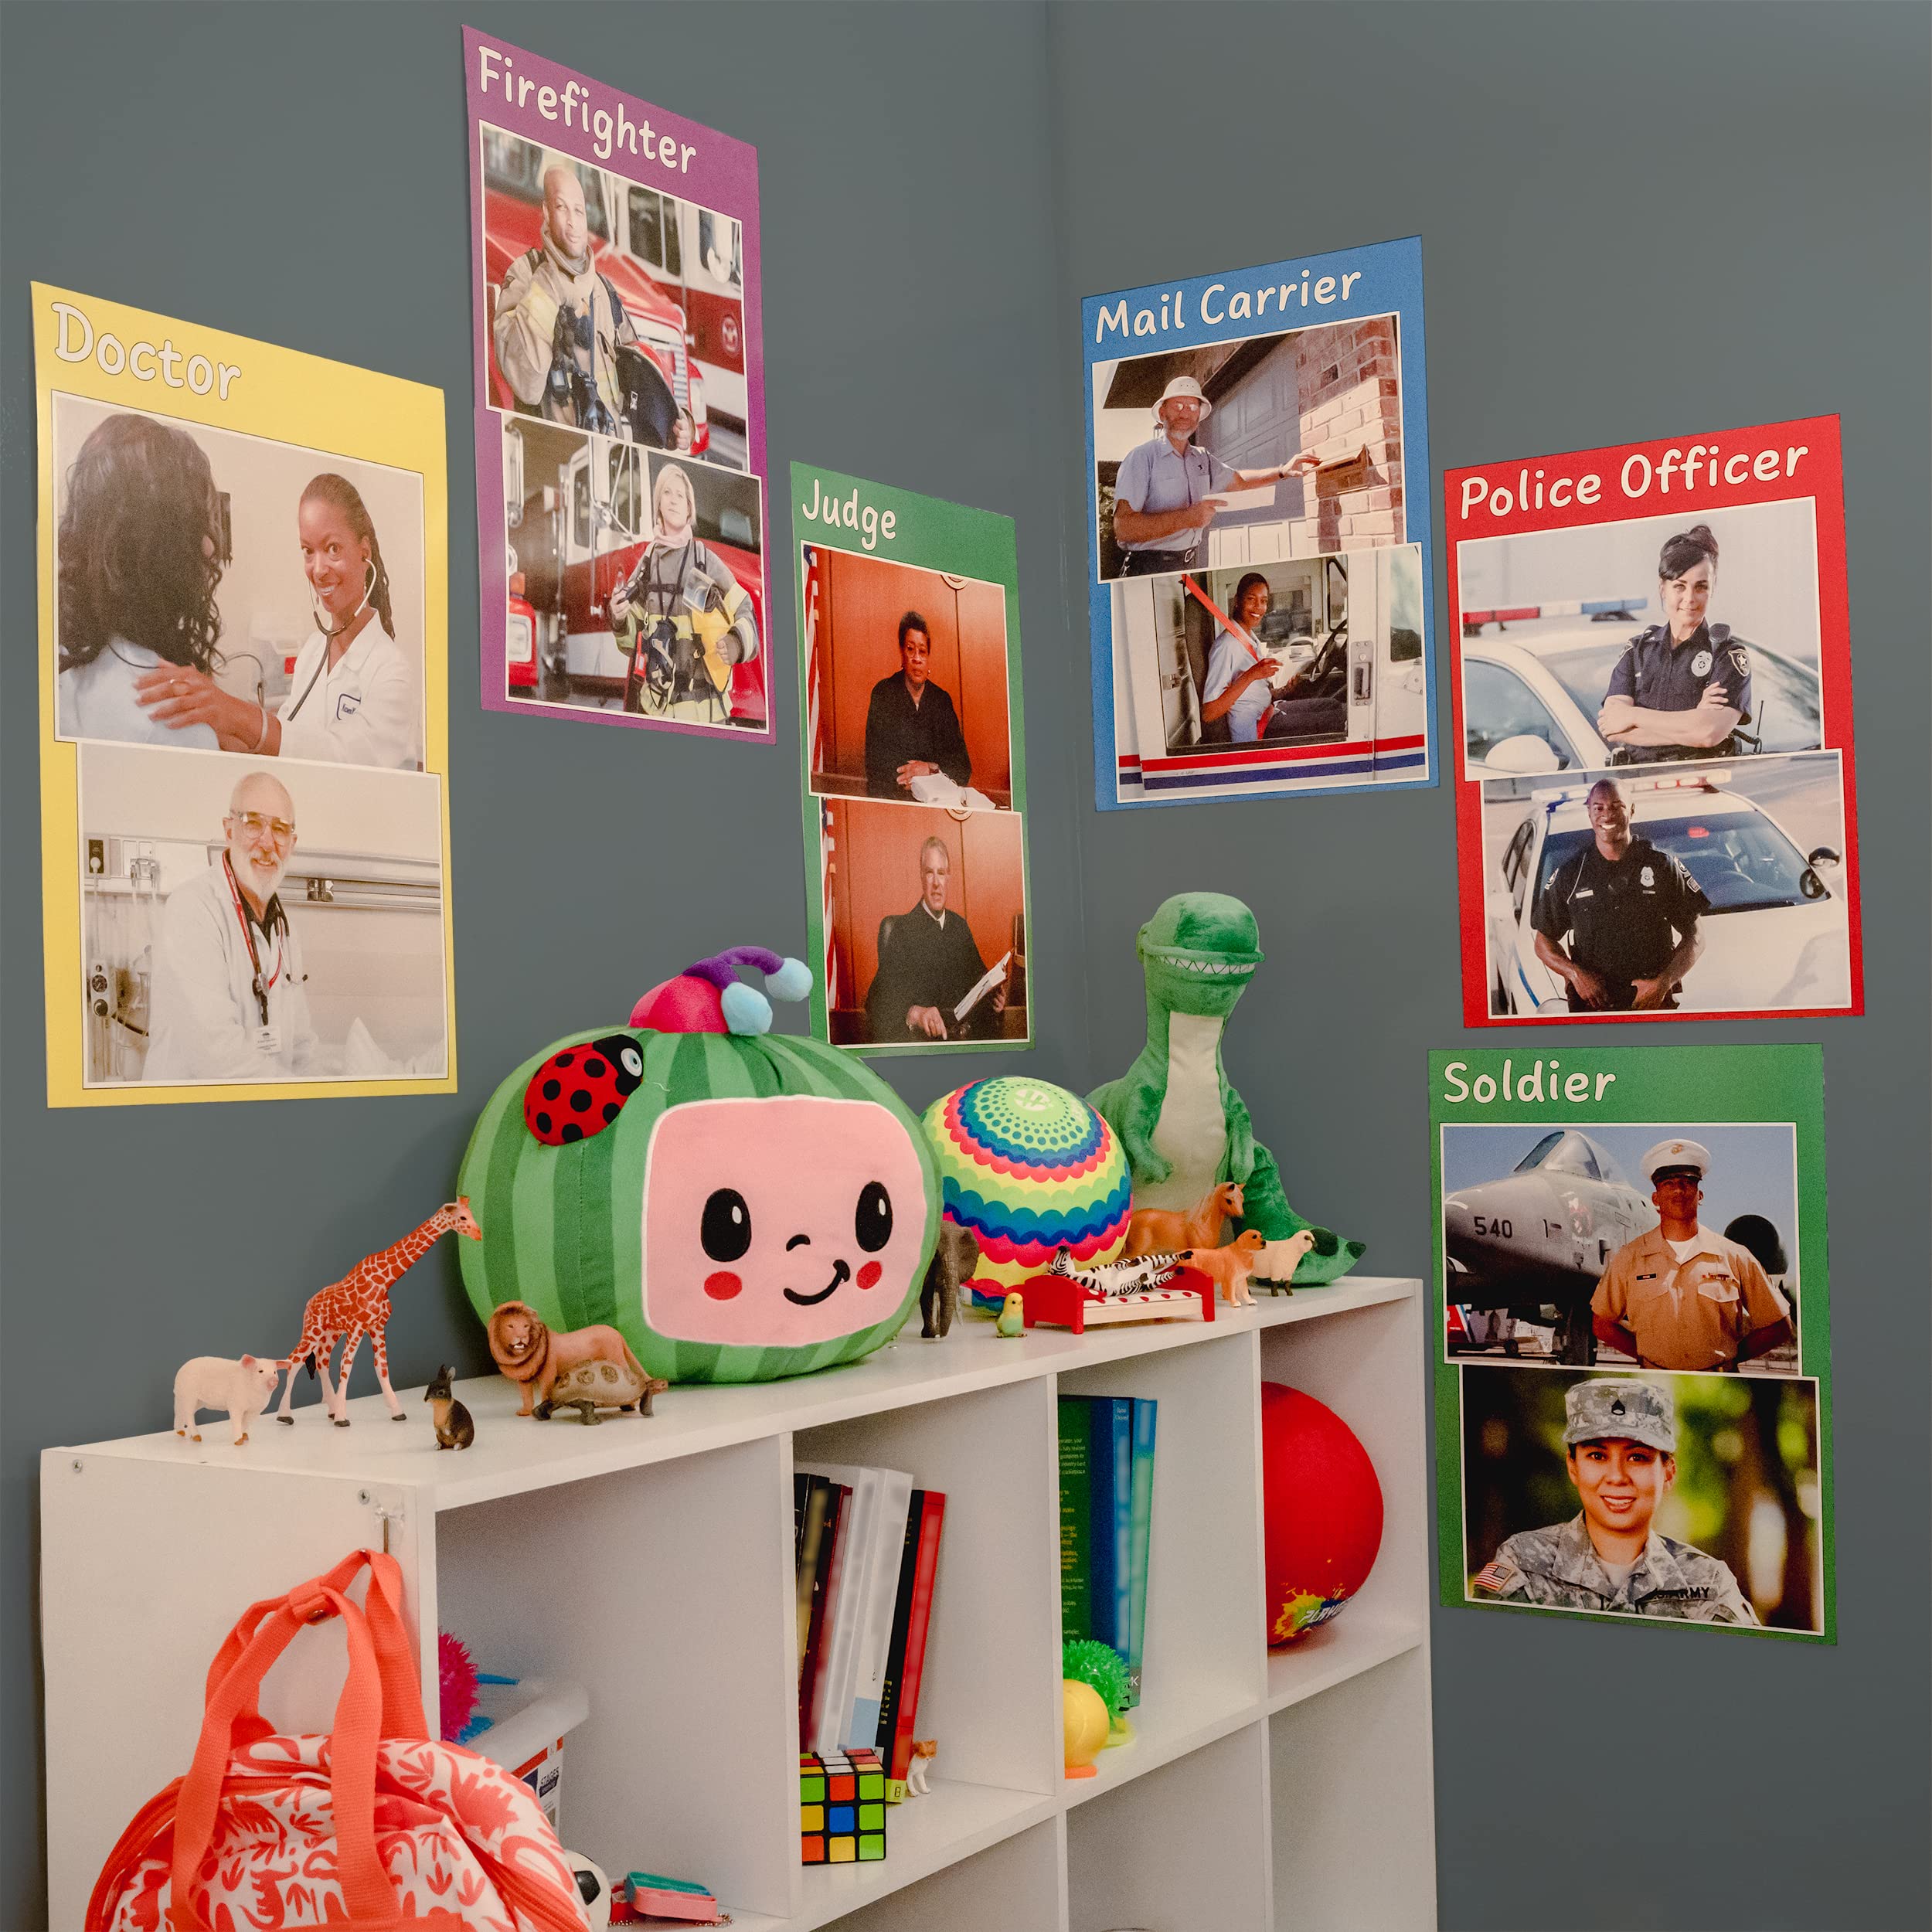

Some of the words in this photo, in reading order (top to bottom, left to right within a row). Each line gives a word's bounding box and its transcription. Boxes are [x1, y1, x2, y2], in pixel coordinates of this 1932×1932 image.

[478, 45, 696, 174] Firefighter
[1095, 291, 1185, 344] Mail
[1200, 269, 1362, 325] Carrier
[51, 302, 241, 401] Doctor
[802, 478, 897, 551] Judge
[1460, 469, 1602, 520] Police
[1621, 444, 1809, 498] Officer
[1444, 1059, 1616, 1103] Soldier
[1474, 1216, 1513, 1239] 540
